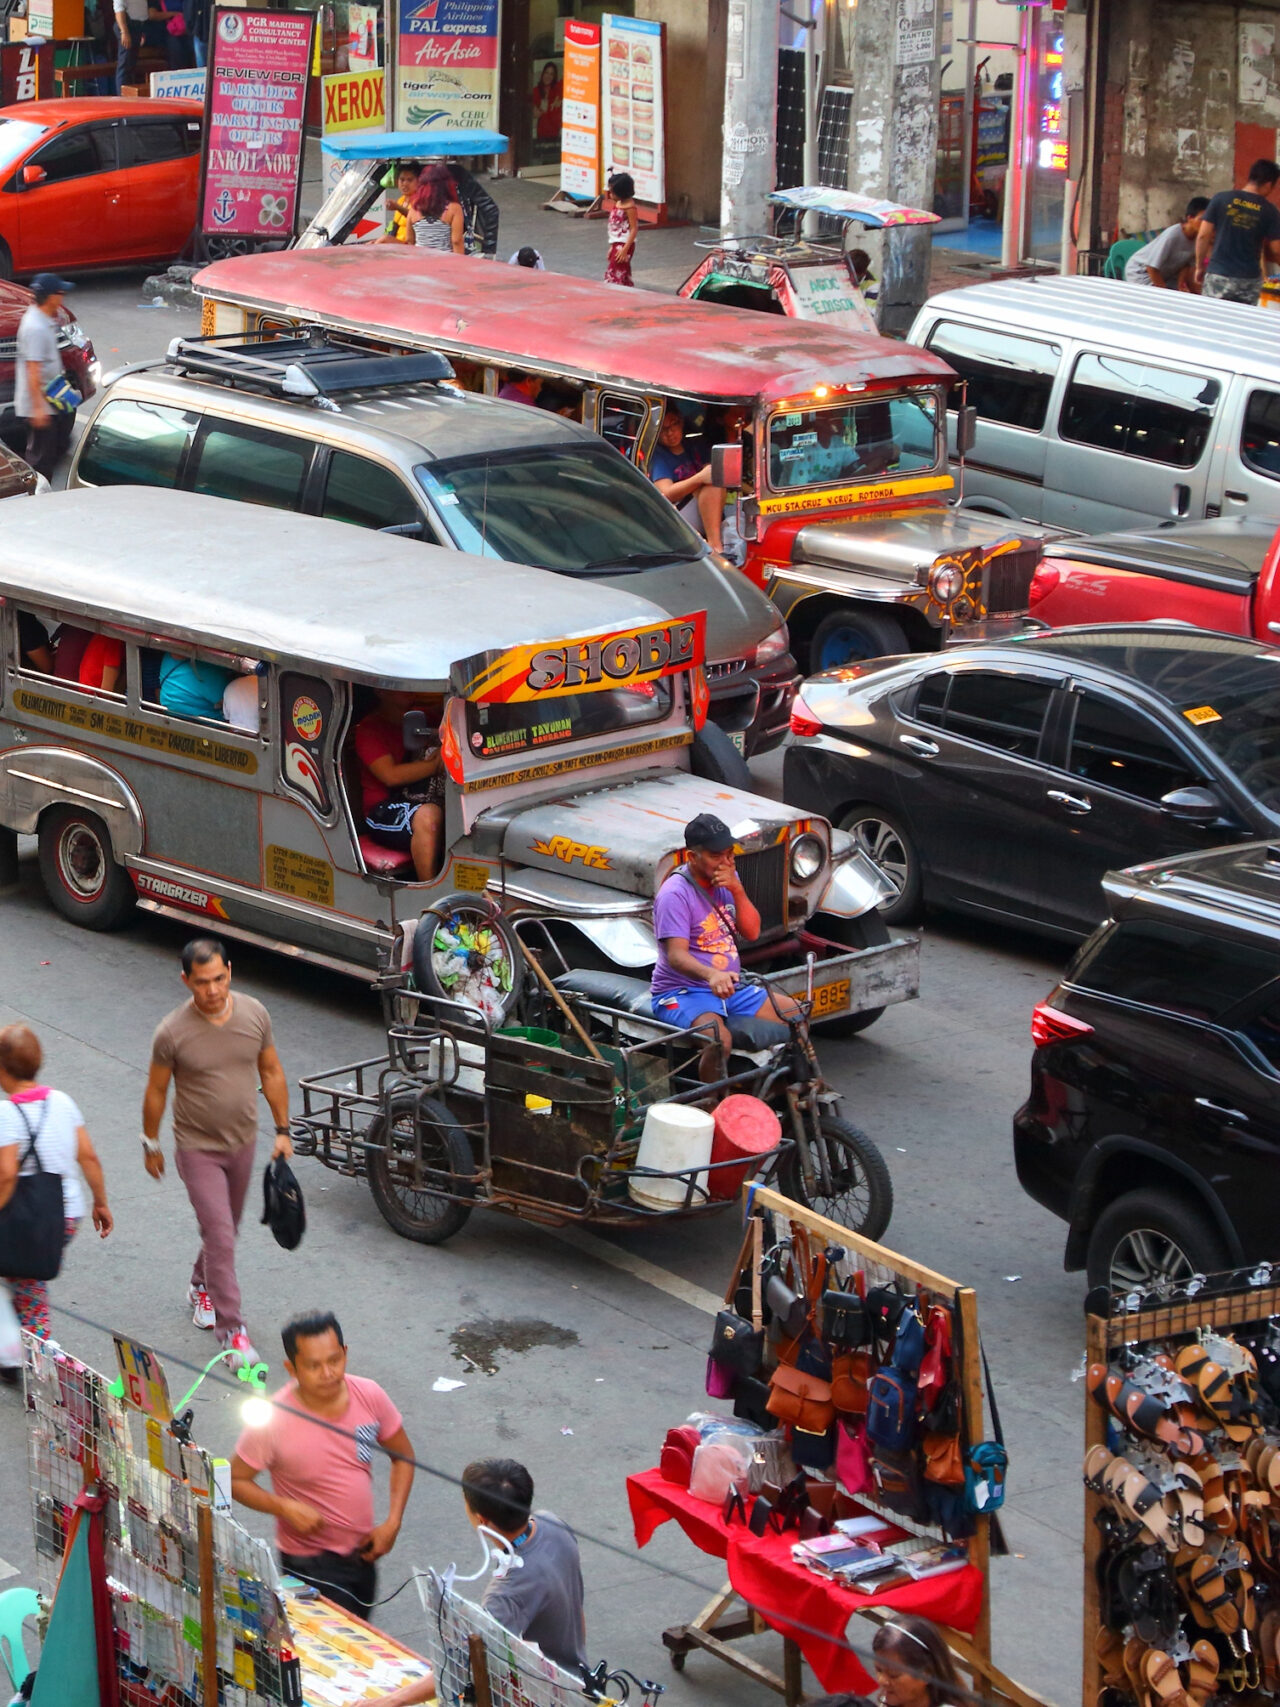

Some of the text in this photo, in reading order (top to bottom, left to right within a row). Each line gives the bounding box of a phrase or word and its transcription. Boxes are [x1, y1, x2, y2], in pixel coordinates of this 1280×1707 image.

[444, 1, 495, 12] Philippine
[444, 12, 484, 21] Airlines
[246, 17, 305, 30] PGR MARITIME
[410, 21, 487, 34] PAL express
[249, 28, 301, 38] CONSULTANCY
[900, 30, 932, 40] WANTED
[250, 36, 278, 44] REVIEW
[279, 38, 307, 46] CENTER
[216, 66, 305, 82] REVIEW FOR:
[157, 84, 206, 98] DENTAL
[219, 82, 297, 100] MARINE DECK
[403, 81, 434, 90] tiger
[232, 98, 284, 114] OFFICERS
[325, 77, 385, 124] XEROX
[461, 110, 489, 119] CEBU
[212, 113, 300, 131] MARINE ENGINE
[447, 119, 487, 128] PACIFIC
[208, 149, 299, 175] ENROLL NOW!
[859, 488, 894, 501] ROTONDA
[526, 621, 696, 691] SHOBE
[531, 718, 572, 737] TAYUMAN
[138, 874, 208, 907] STARGAZER
